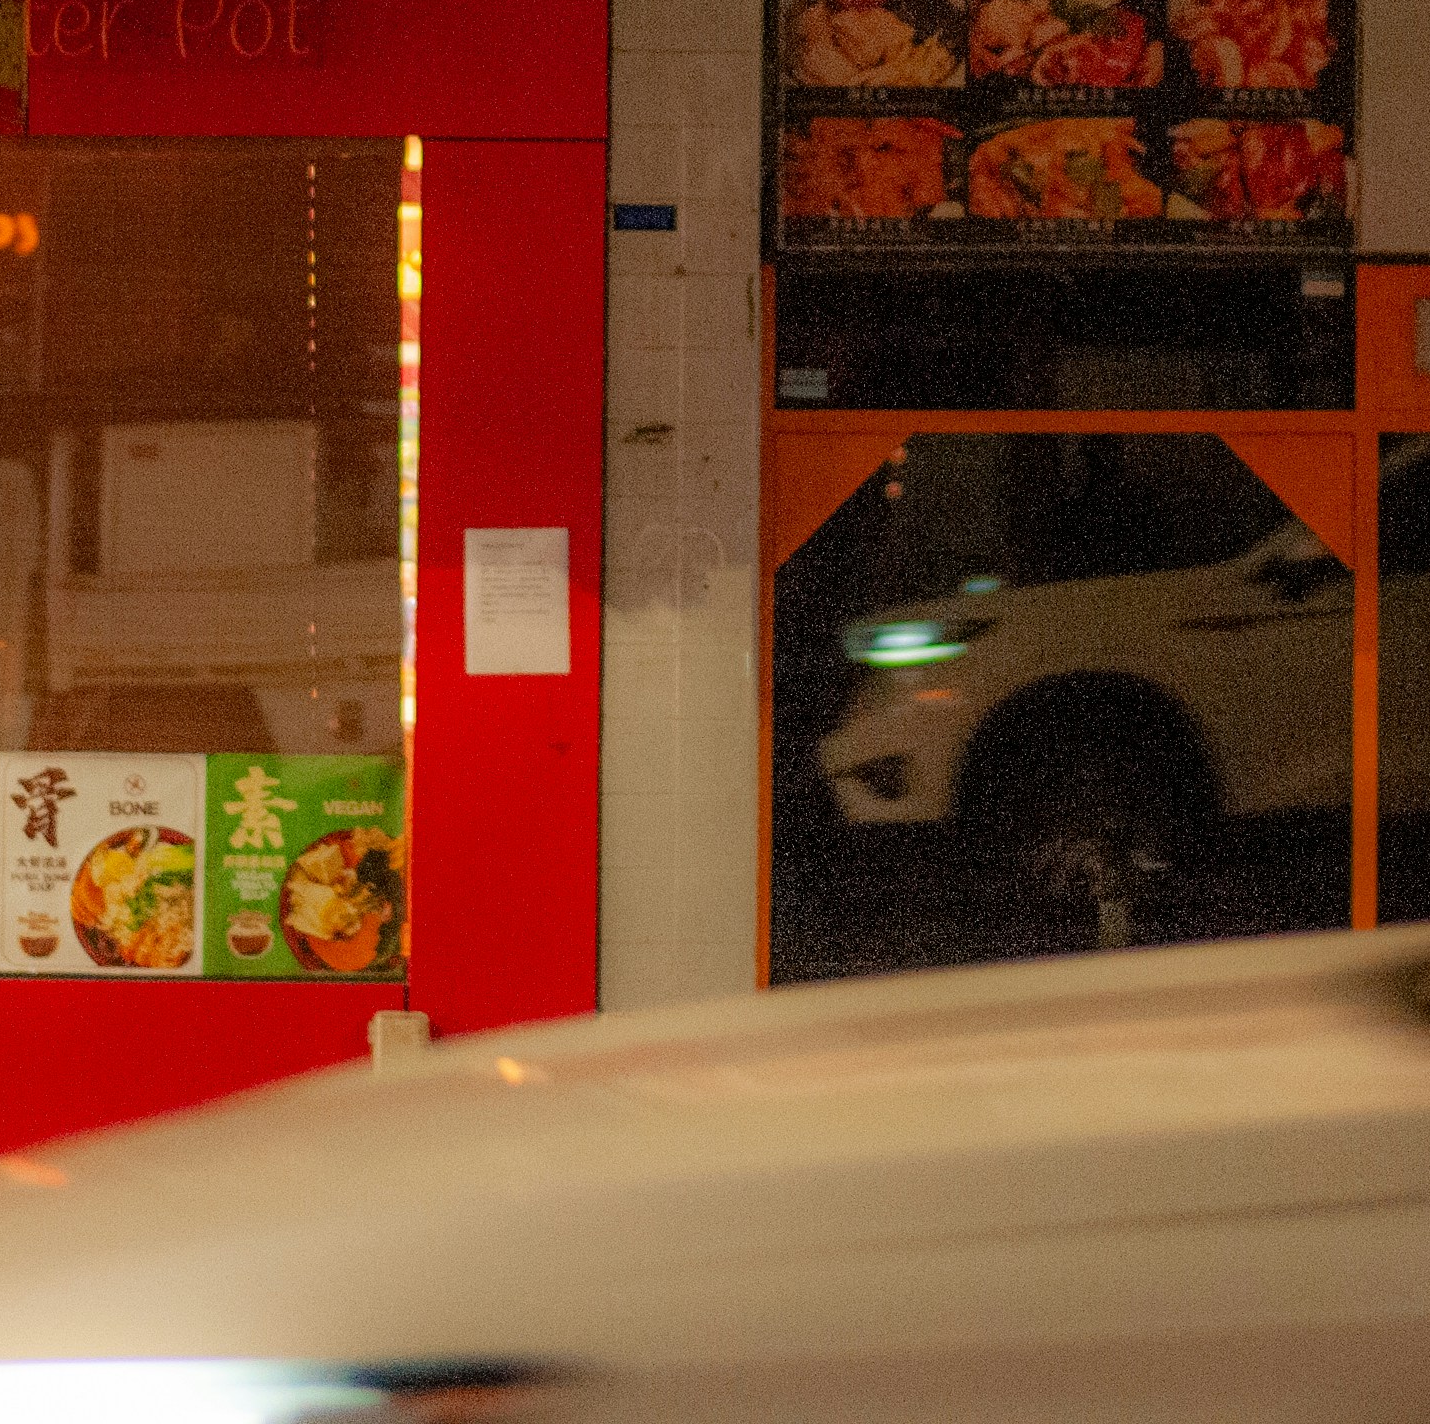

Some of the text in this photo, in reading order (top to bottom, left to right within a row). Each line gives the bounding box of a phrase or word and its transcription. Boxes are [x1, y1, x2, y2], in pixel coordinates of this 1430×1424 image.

[10, 765, 78, 848] 骨
[108, 800, 161, 817] BONE
[222, 765, 299, 850] 素
[322, 799, 385, 817] VEGAN
